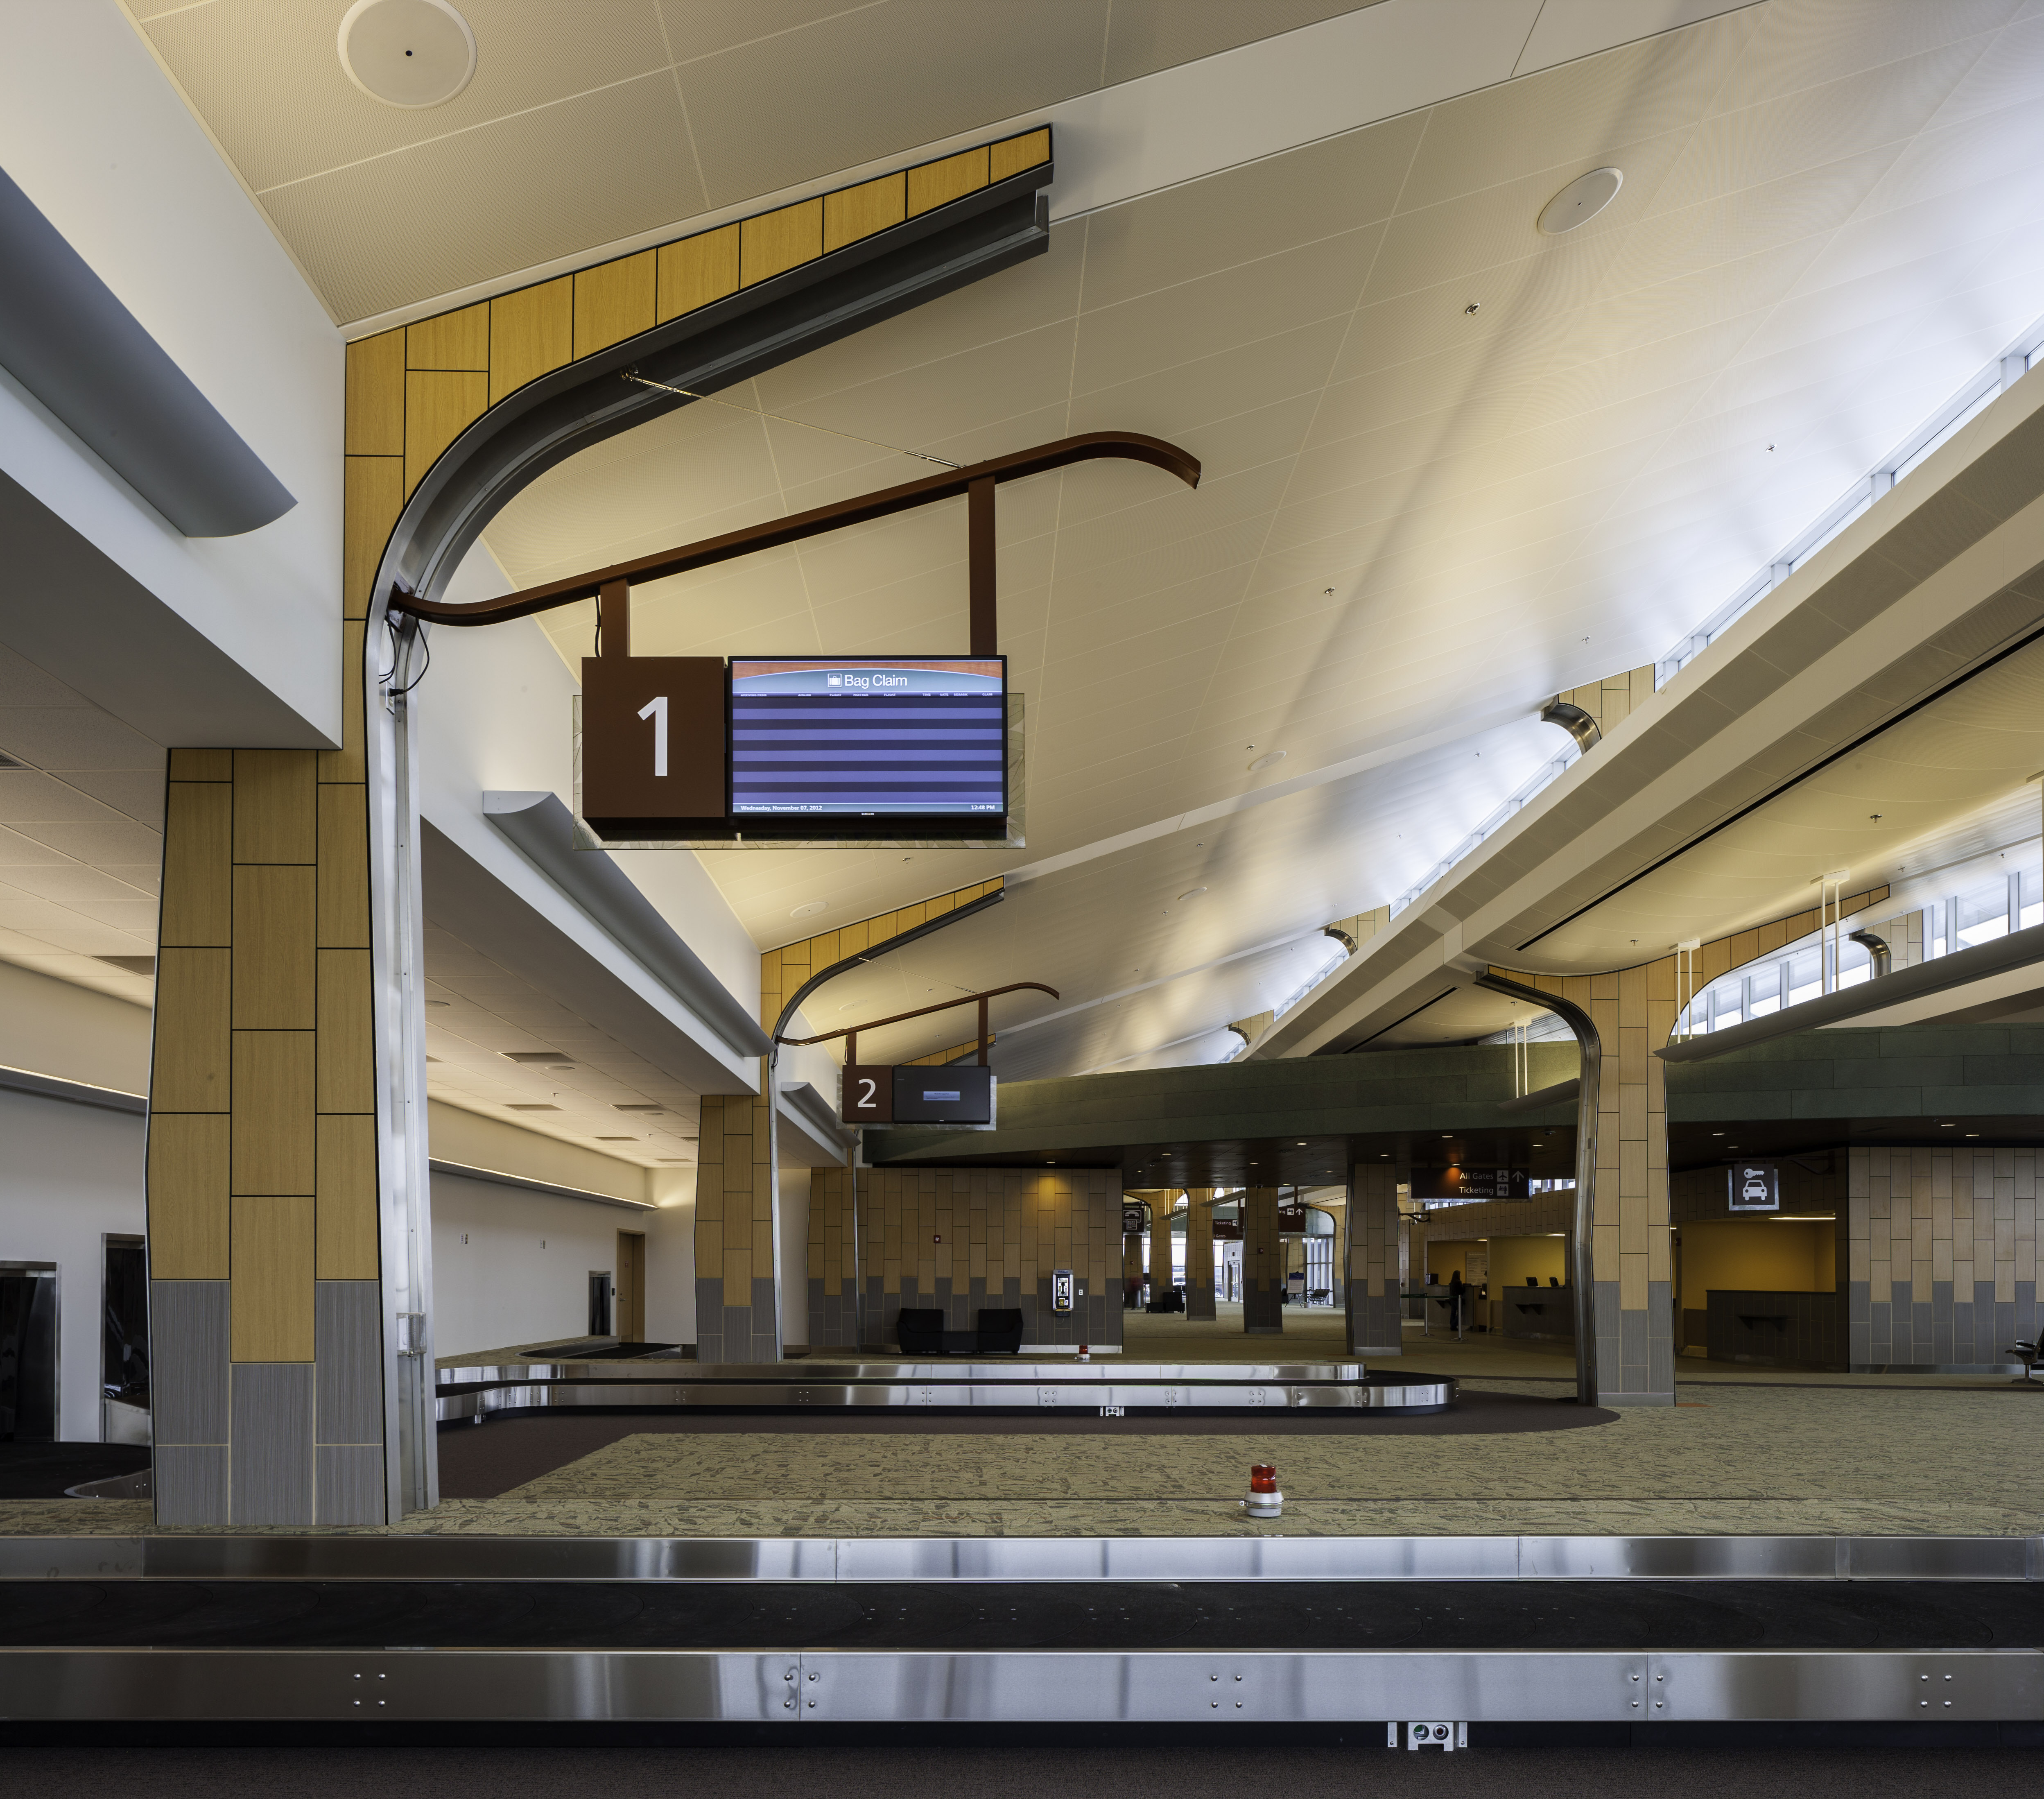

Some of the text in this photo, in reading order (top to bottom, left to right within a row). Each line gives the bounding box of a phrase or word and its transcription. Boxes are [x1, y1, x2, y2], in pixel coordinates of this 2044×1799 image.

[845, 674, 907, 689] Bag Claim
[637, 697, 667, 776] 1
[858, 1078, 876, 1107] 2
[1459, 1186, 1494, 1195] Ticketing
